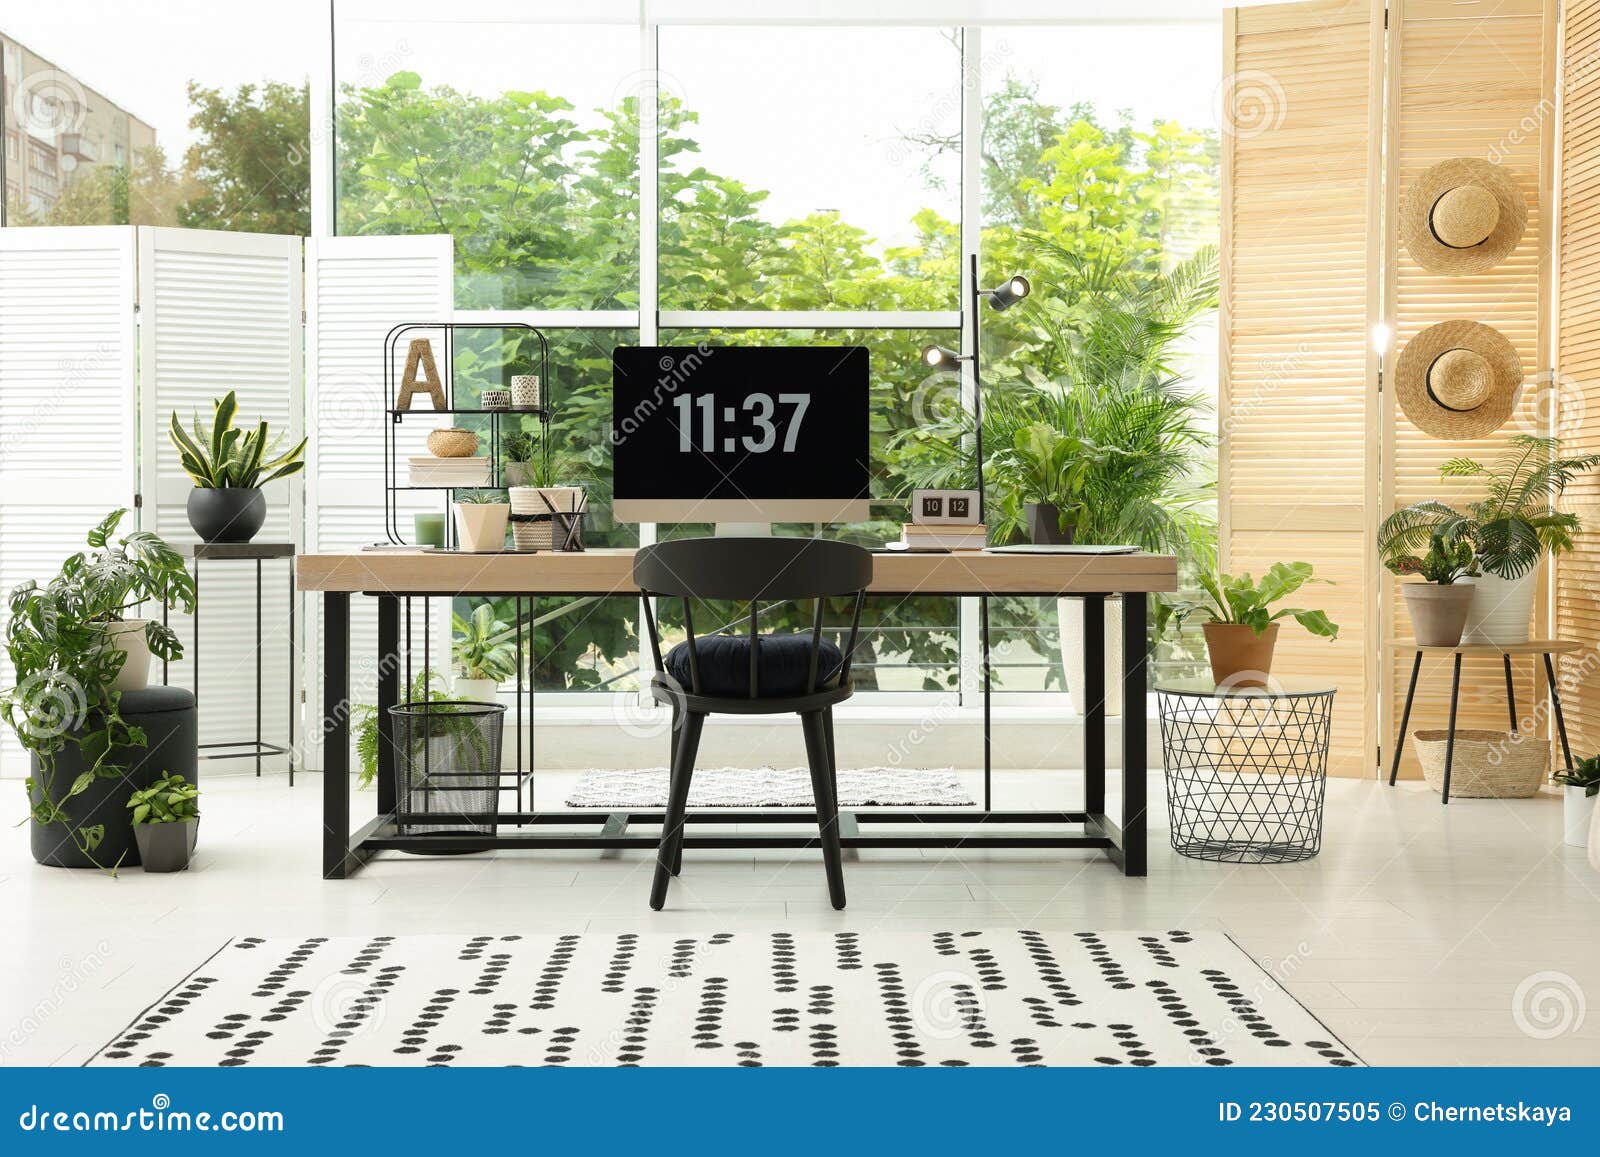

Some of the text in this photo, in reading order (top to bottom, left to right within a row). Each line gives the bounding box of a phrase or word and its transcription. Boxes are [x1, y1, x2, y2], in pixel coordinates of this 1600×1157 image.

[396, 338, 447, 411] A
[673, 392, 811, 453] 11:37
[926, 500, 965, 512] 10 12
